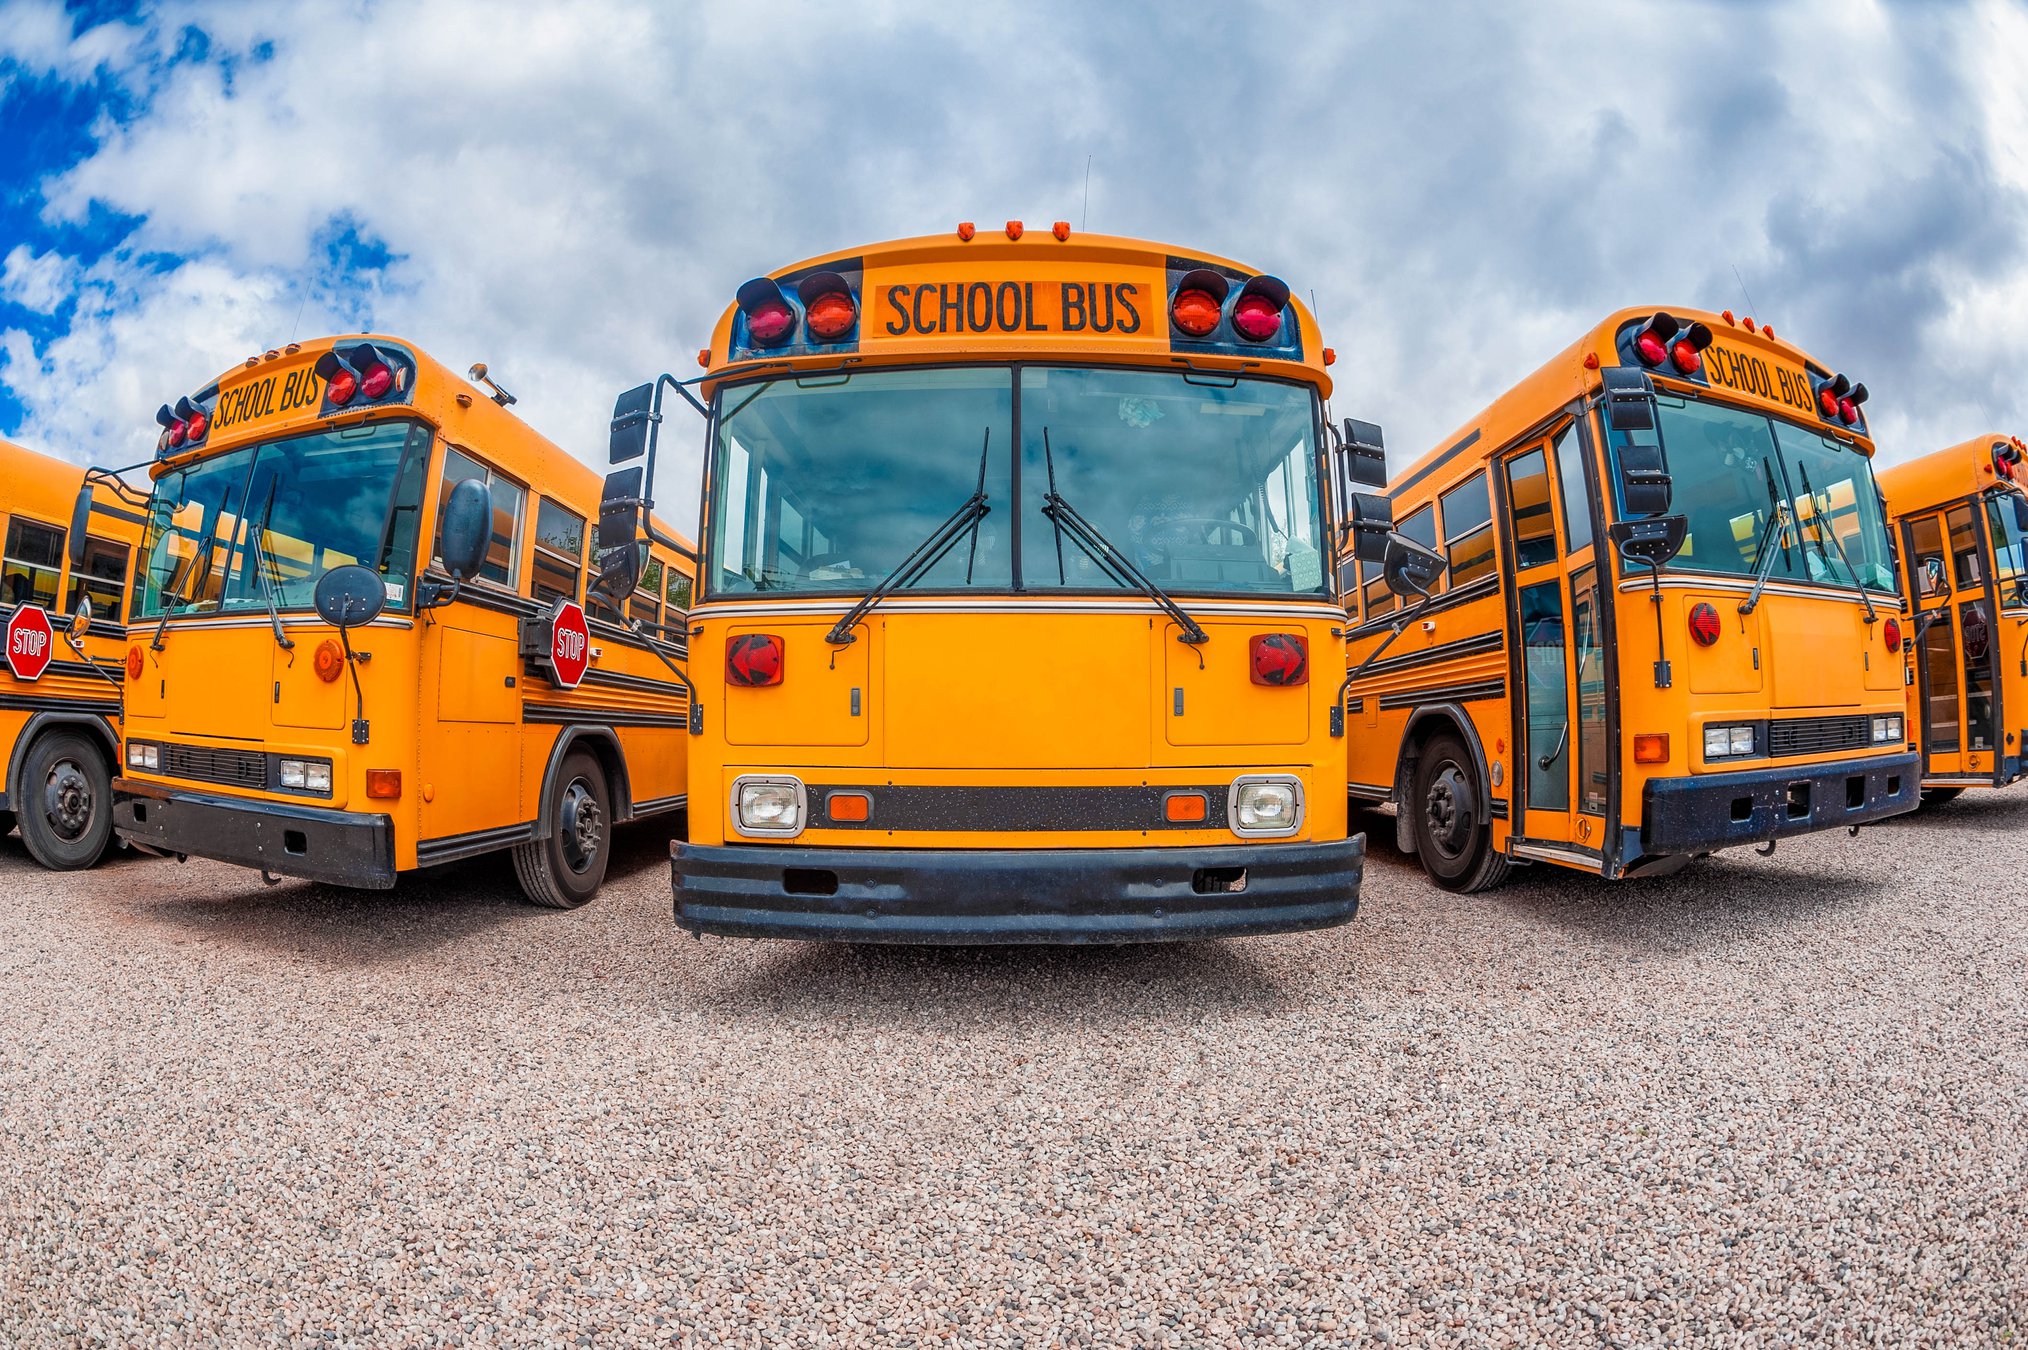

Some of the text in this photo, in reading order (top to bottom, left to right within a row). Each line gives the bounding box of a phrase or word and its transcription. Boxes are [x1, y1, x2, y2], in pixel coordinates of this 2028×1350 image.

[886, 281, 1141, 335] SCHOOL BUS
[214, 367, 319, 430] SCHOOL BUS
[1704, 345, 1813, 412] SCHOOL BUS
[13, 627, 47, 657] STOP
[556, 627, 585, 662] STOP
